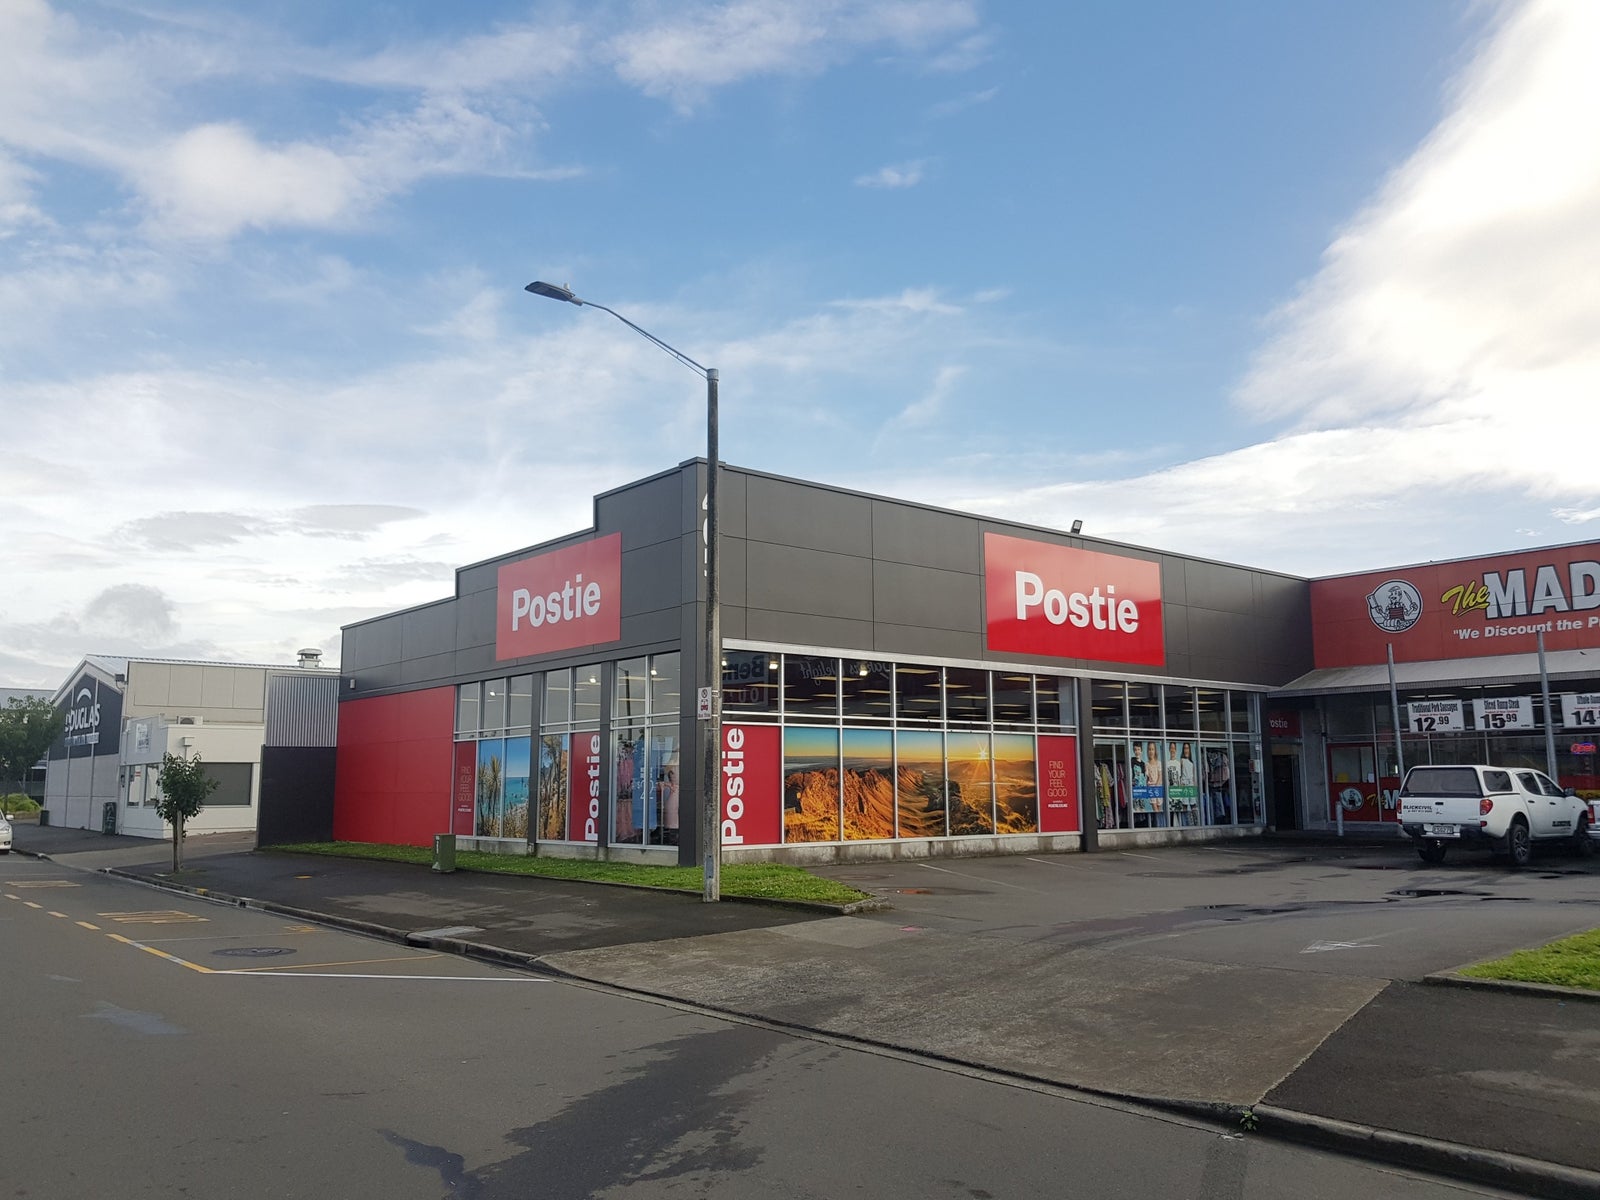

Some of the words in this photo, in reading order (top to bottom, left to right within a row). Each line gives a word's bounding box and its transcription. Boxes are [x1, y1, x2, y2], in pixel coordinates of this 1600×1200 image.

[513, 574, 600, 631] Postie
[1016, 571, 1138, 632] Postie
[1440, 580, 1490, 617] The
[1453, 627, 1480, 640] "We
[1484, 620, 1552, 638] Discount
[1556, 618, 1583, 632] the
[1269, 717, 1288, 729] ostie
[1048, 760, 1064, 769] FIND
[1048, 769, 1065, 779] YOUR
[585, 735, 600, 841] Postie
[721, 728, 745, 845] Postie
[1047, 788, 1068, 797] GOOD
[1049, 779, 1065, 788] FEEL
